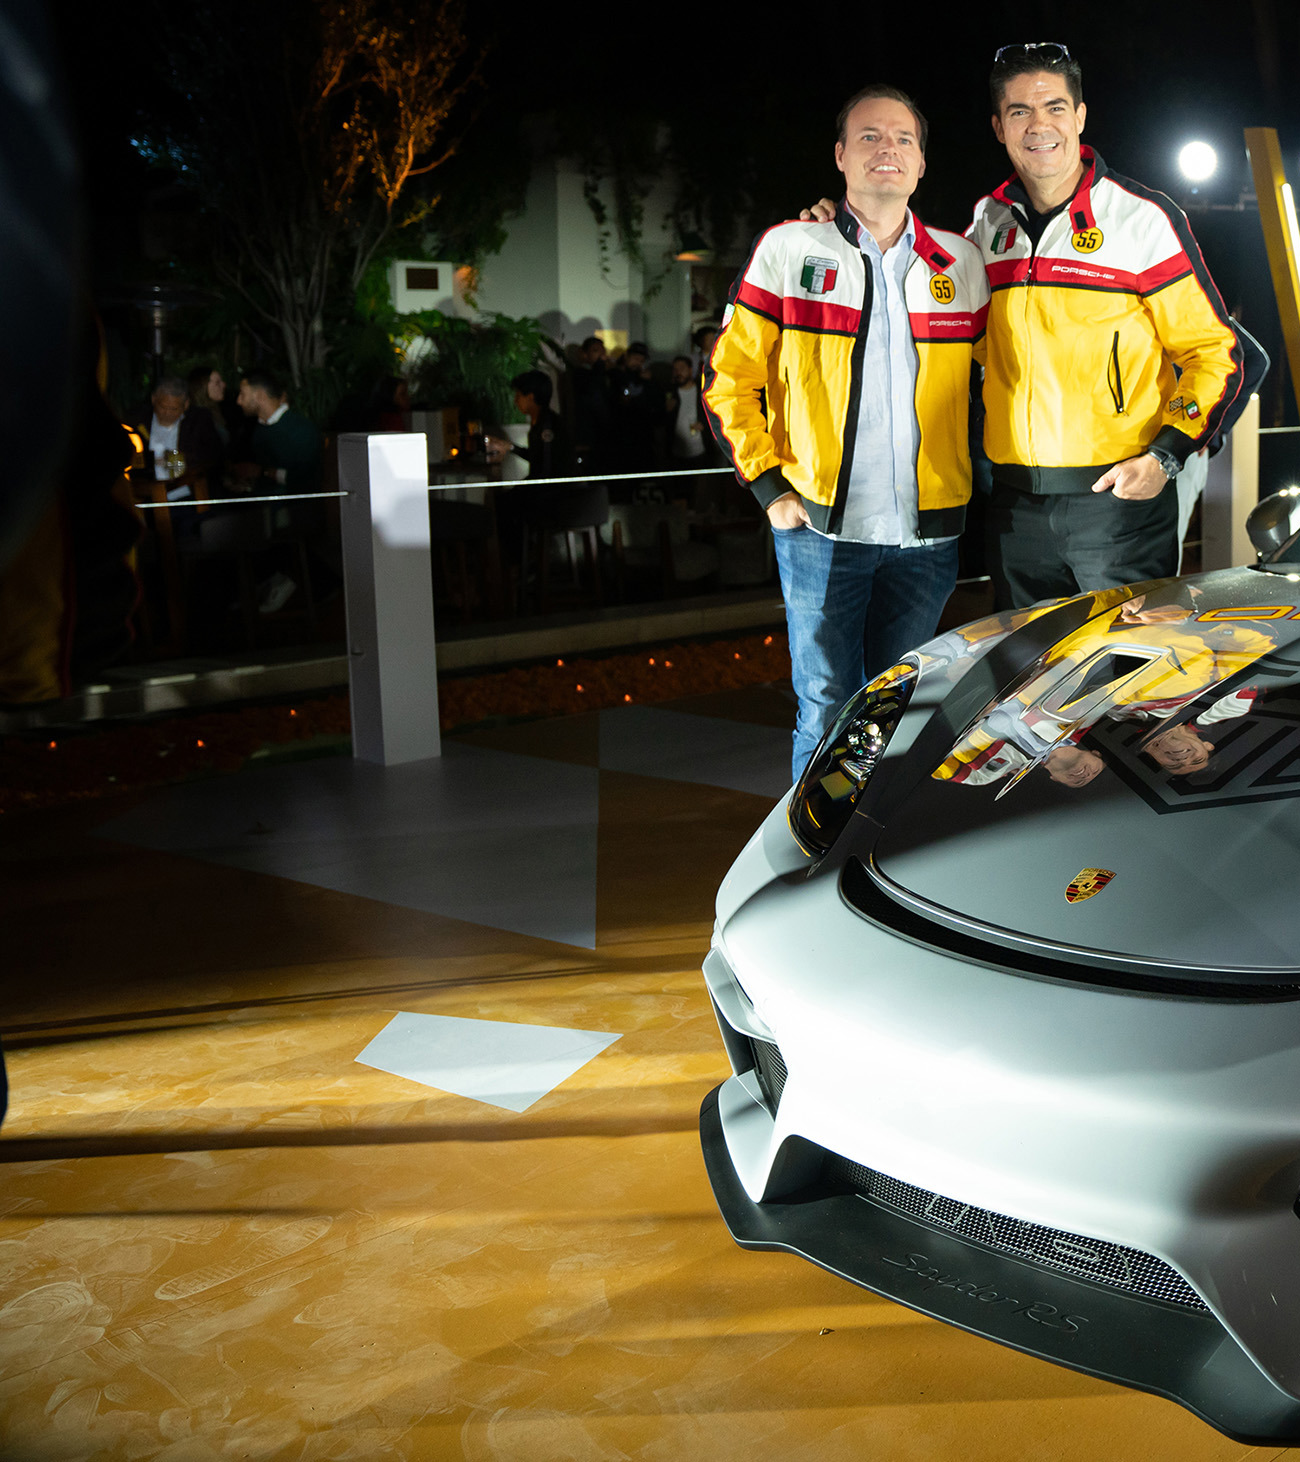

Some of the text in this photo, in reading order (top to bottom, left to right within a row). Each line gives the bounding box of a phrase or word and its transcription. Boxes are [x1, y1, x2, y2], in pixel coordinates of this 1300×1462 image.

[1077, 231, 1098, 249] 55
[1051, 265, 1116, 280] PORSCHE
[933, 280, 951, 299] 55
[882, 1253, 1090, 1334] Spyder RS
